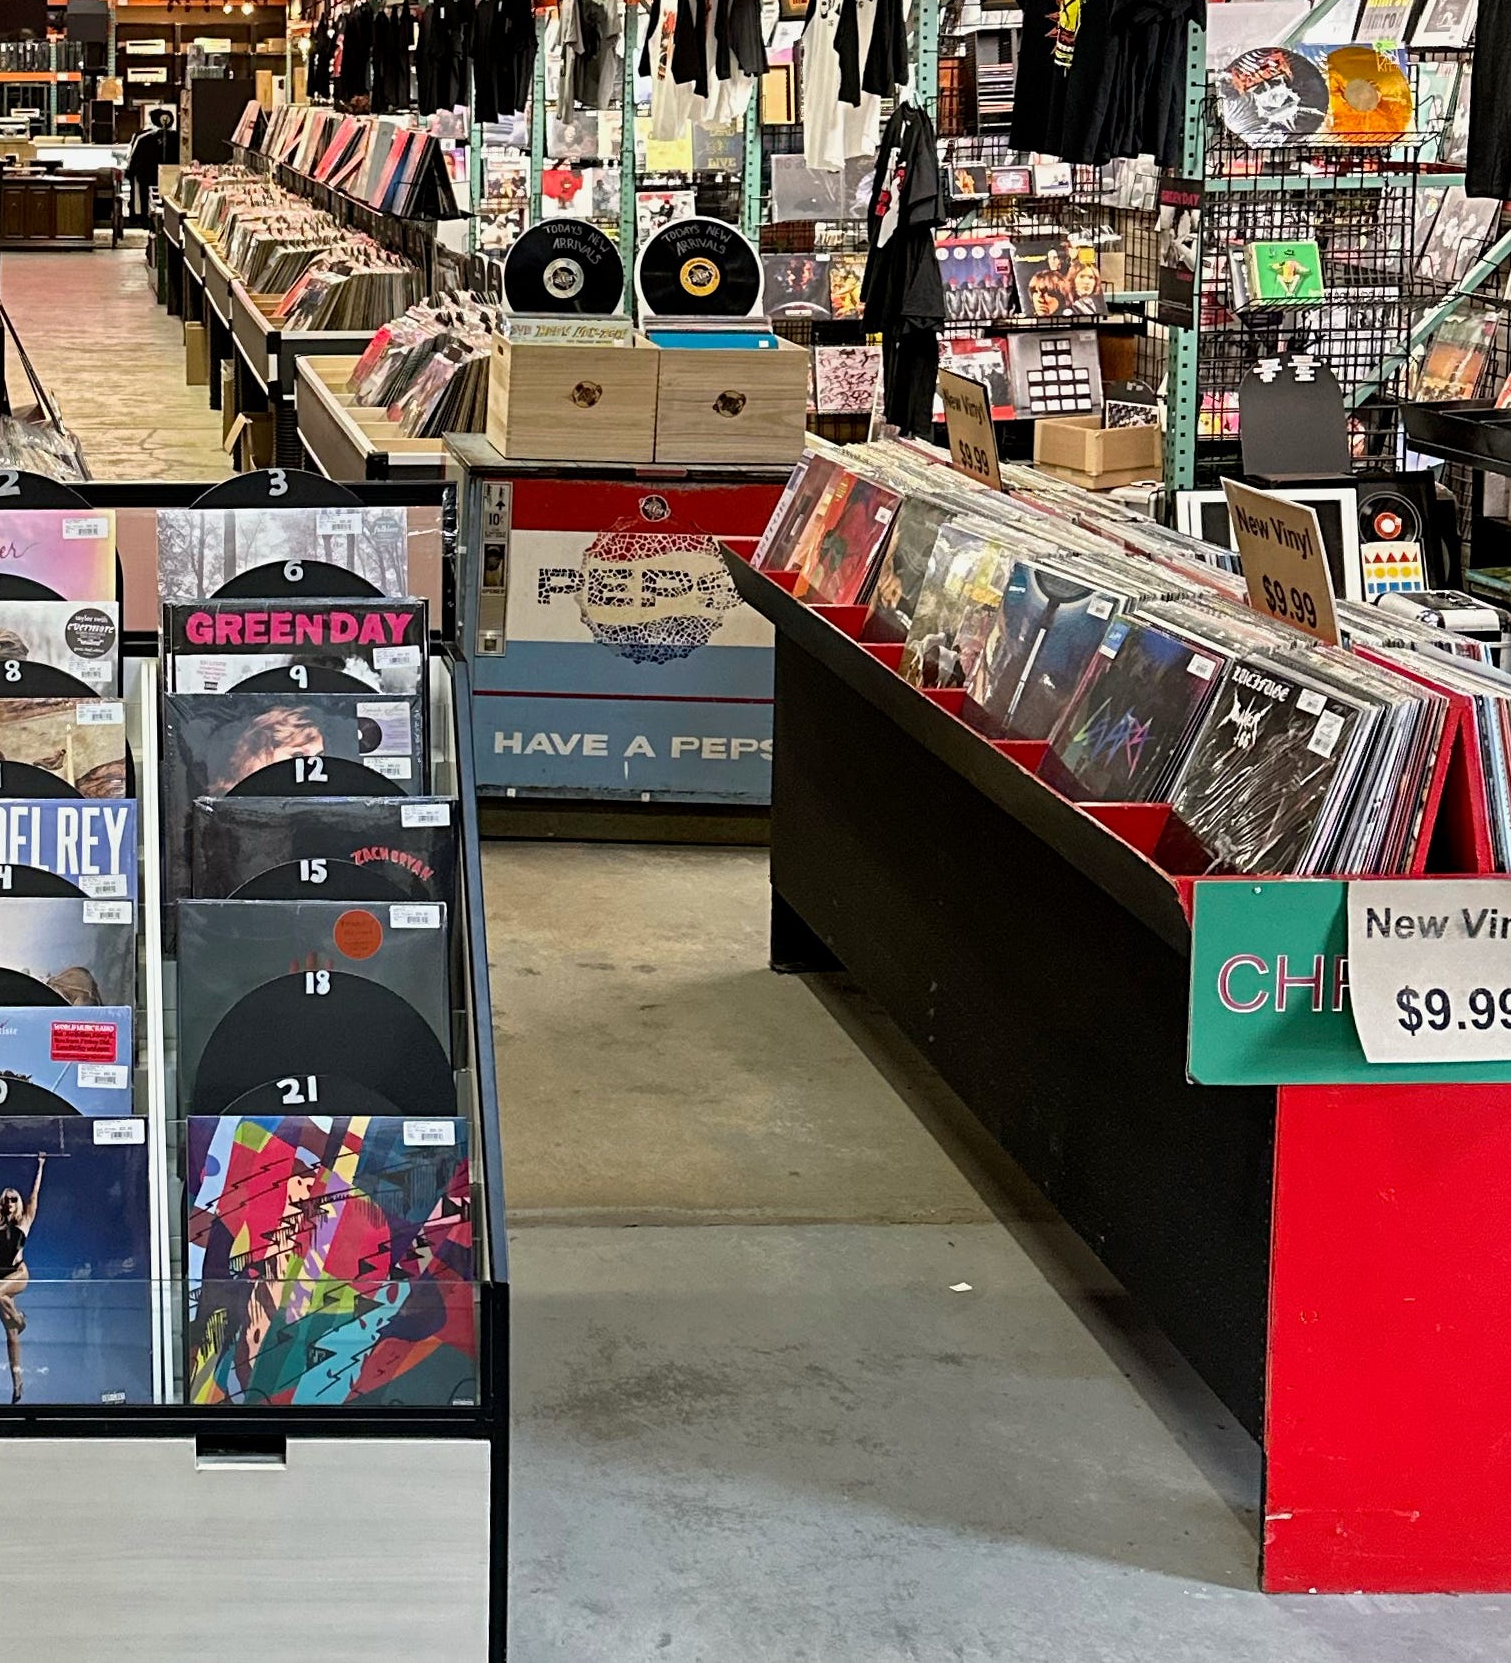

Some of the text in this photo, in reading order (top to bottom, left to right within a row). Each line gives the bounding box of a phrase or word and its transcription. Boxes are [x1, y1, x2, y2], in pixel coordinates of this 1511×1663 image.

[588, 231, 610, 254] NEW
[676, 237, 727, 257] ARRIVALS
[706, 224, 732, 243] NEW
[553, 237, 602, 266] ARRIVALS
[962, 395, 986, 425] Vinyl
[959, 439, 990, 477] $9.99
[268, 468, 288, 497] 3
[1236, 504, 1314, 561] New Vinyl
[283, 559, 304, 582] 6
[1262, 575, 1318, 629] $9.99
[67, 623, 115, 634] evermore
[185, 611, 414, 646] GREEN DAY
[4, 659, 22, 682] 8
[289, 664, 308, 689] 9
[494, 731, 609, 757] HAVE
[623, 735, 656, 757] A
[295, 756, 328, 784] 12
[57, 806, 127, 876] REY
[300, 859, 327, 883] 15
[350, 846, 435, 882] ZACH BRYAN
[1365, 907, 1450, 939] New
[305, 970, 331, 995] 18
[276, 1075, 318, 1105] 21
